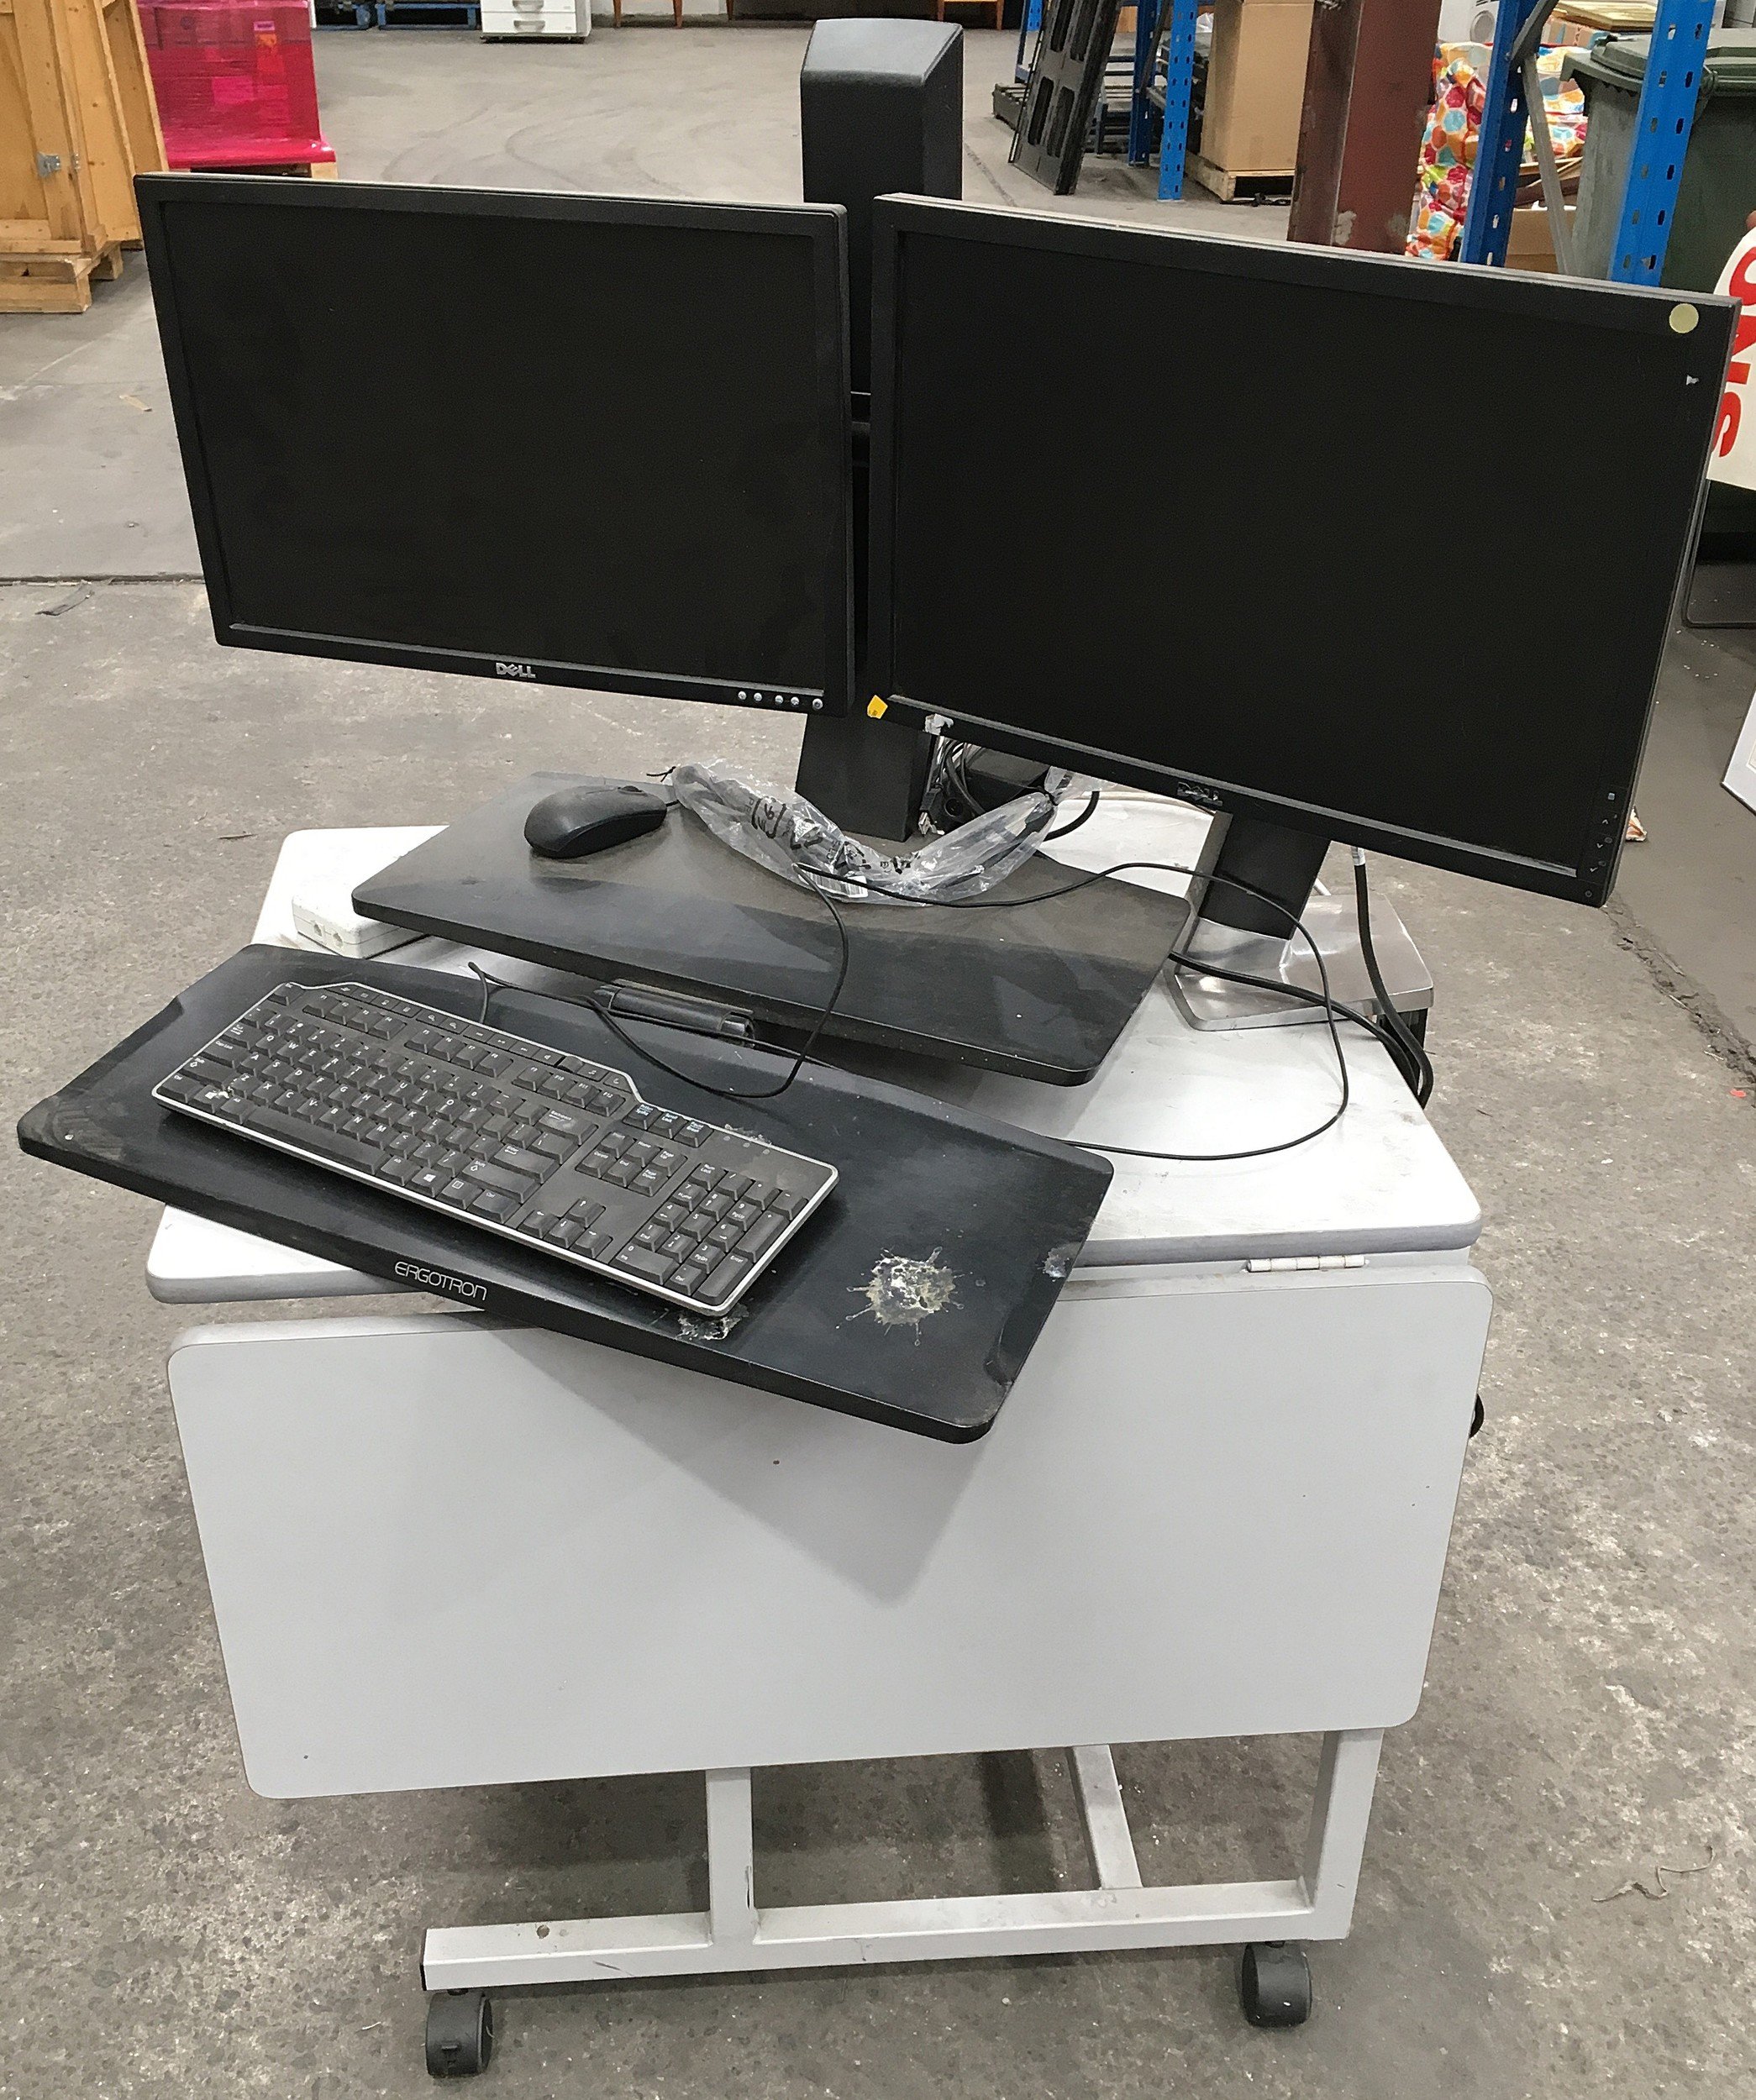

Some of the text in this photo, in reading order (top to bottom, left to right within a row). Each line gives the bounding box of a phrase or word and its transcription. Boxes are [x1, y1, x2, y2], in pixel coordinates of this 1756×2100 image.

[495, 662, 536, 679] DELL
[353, 1116, 363, 1124] N
[394, 1261, 488, 1301] ERGOTRON
